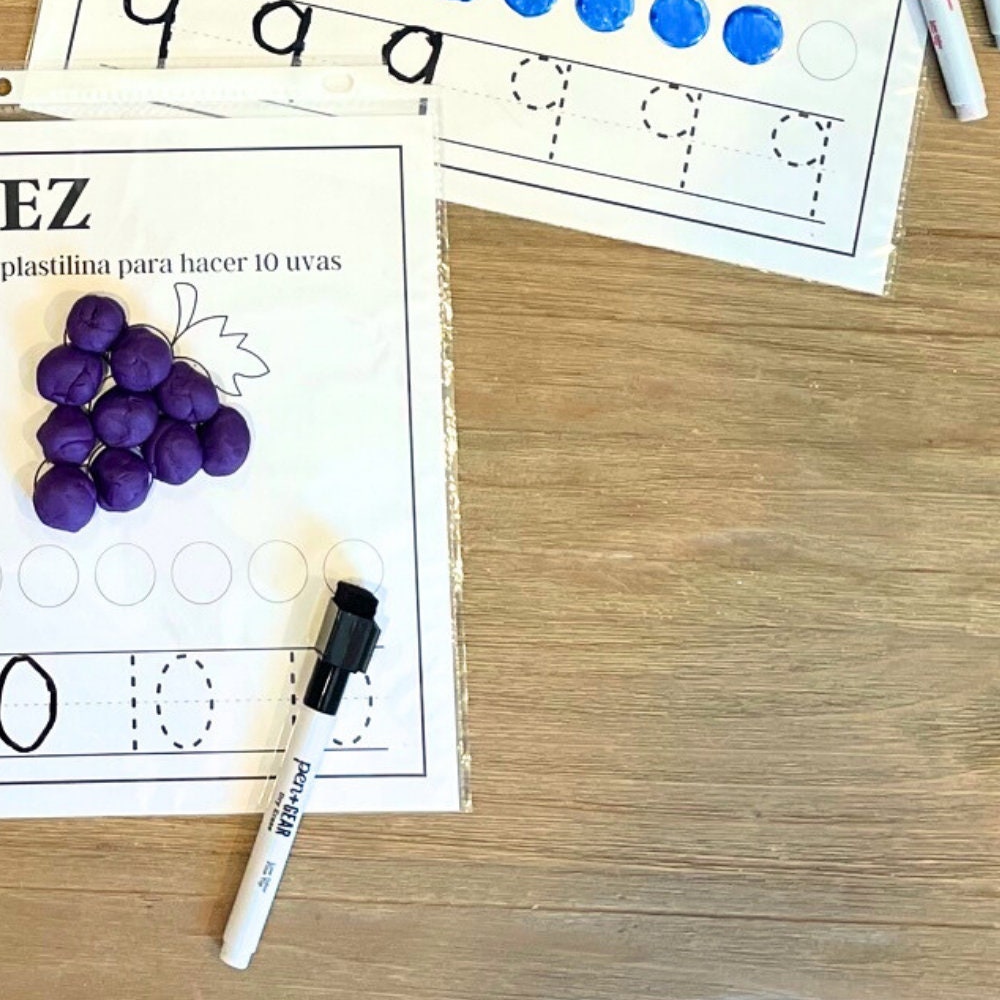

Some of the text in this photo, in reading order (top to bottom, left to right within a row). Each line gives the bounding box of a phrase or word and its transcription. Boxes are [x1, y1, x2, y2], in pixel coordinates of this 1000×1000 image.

[0, 254, 111, 283] plastilina
[118, 258, 173, 280] para
[179, 252, 249, 274] hacer
[255, 252, 280, 273] 10
[286, 254, 342, 272] uvas
[130, 653, 215, 751] 10
[275, 757, 312, 838] pen+GEAR
